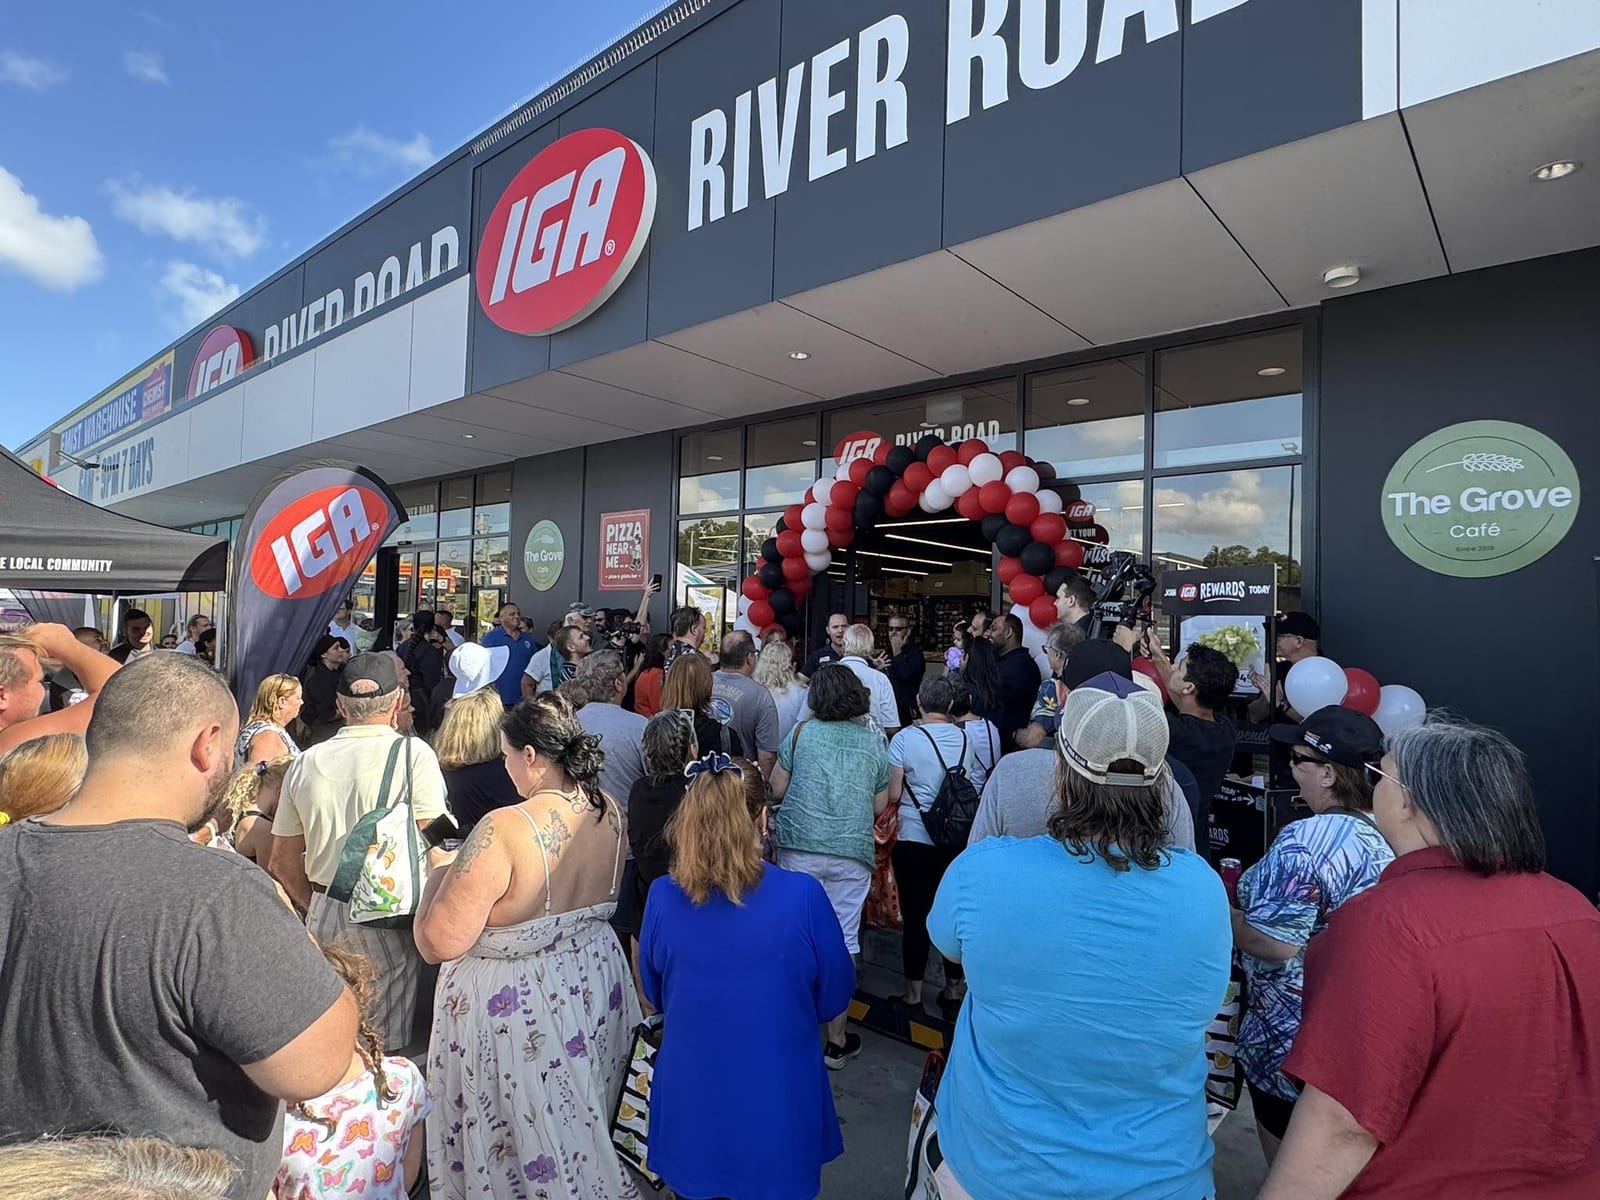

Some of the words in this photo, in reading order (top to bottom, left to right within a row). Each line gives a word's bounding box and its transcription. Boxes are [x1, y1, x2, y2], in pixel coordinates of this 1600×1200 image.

[489, 146, 626, 306] IGA
[687, 14, 909, 232] RIVER
[195, 341, 240, 397] IGA
[84, 388, 137, 447] WAREHOUSE
[120, 448, 129, 493] 7
[128, 437, 154, 490] DAYS
[1069, 504, 1094, 518] IGA
[1387, 491, 1451, 517] The
[1459, 486, 1573, 513] Grove
[606, 521, 642, 543] PIZZA
[1078, 528, 1097, 538] YOUR
[1449, 522, 1501, 538] Café
[271, 488, 371, 596] IGA
[605, 542, 629, 556] NEAR
[9, 557, 45, 571] LOCAL
[46, 558, 113, 573] COMMUNITY
[525, 551, 540, 563] The
[540, 550, 564, 562] Grove
[1180, 586, 1197, 598] IGA
[1200, 580, 1245, 600] REWARDS
[1248, 584, 1271, 595] TODAY
